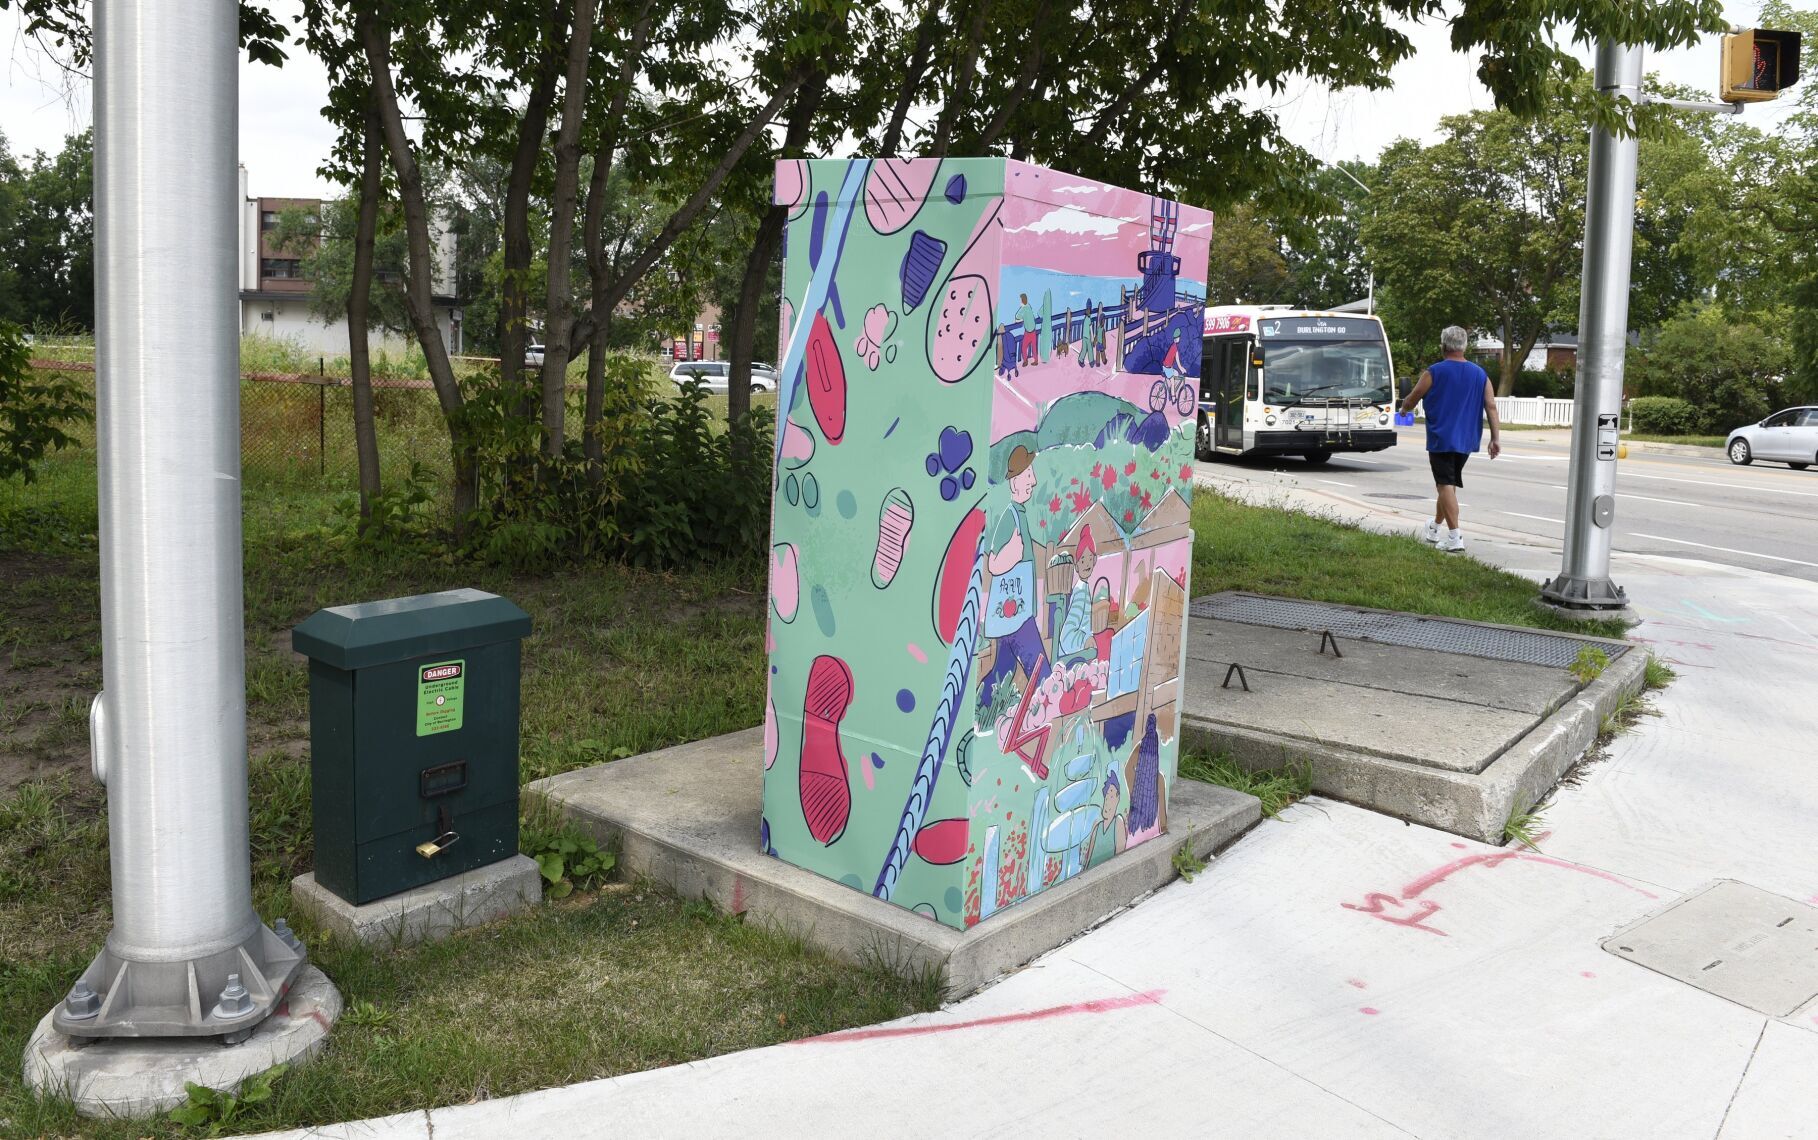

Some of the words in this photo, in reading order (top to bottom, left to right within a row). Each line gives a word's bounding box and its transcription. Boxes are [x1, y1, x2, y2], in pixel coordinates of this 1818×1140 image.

[1274, 321, 1281, 334] 2
[1297, 326, 1336, 334] BURLINGTON
[1337, 326, 1346, 334] GO
[427, 668, 457, 678] DANGER
[425, 681, 458, 689] Underground
